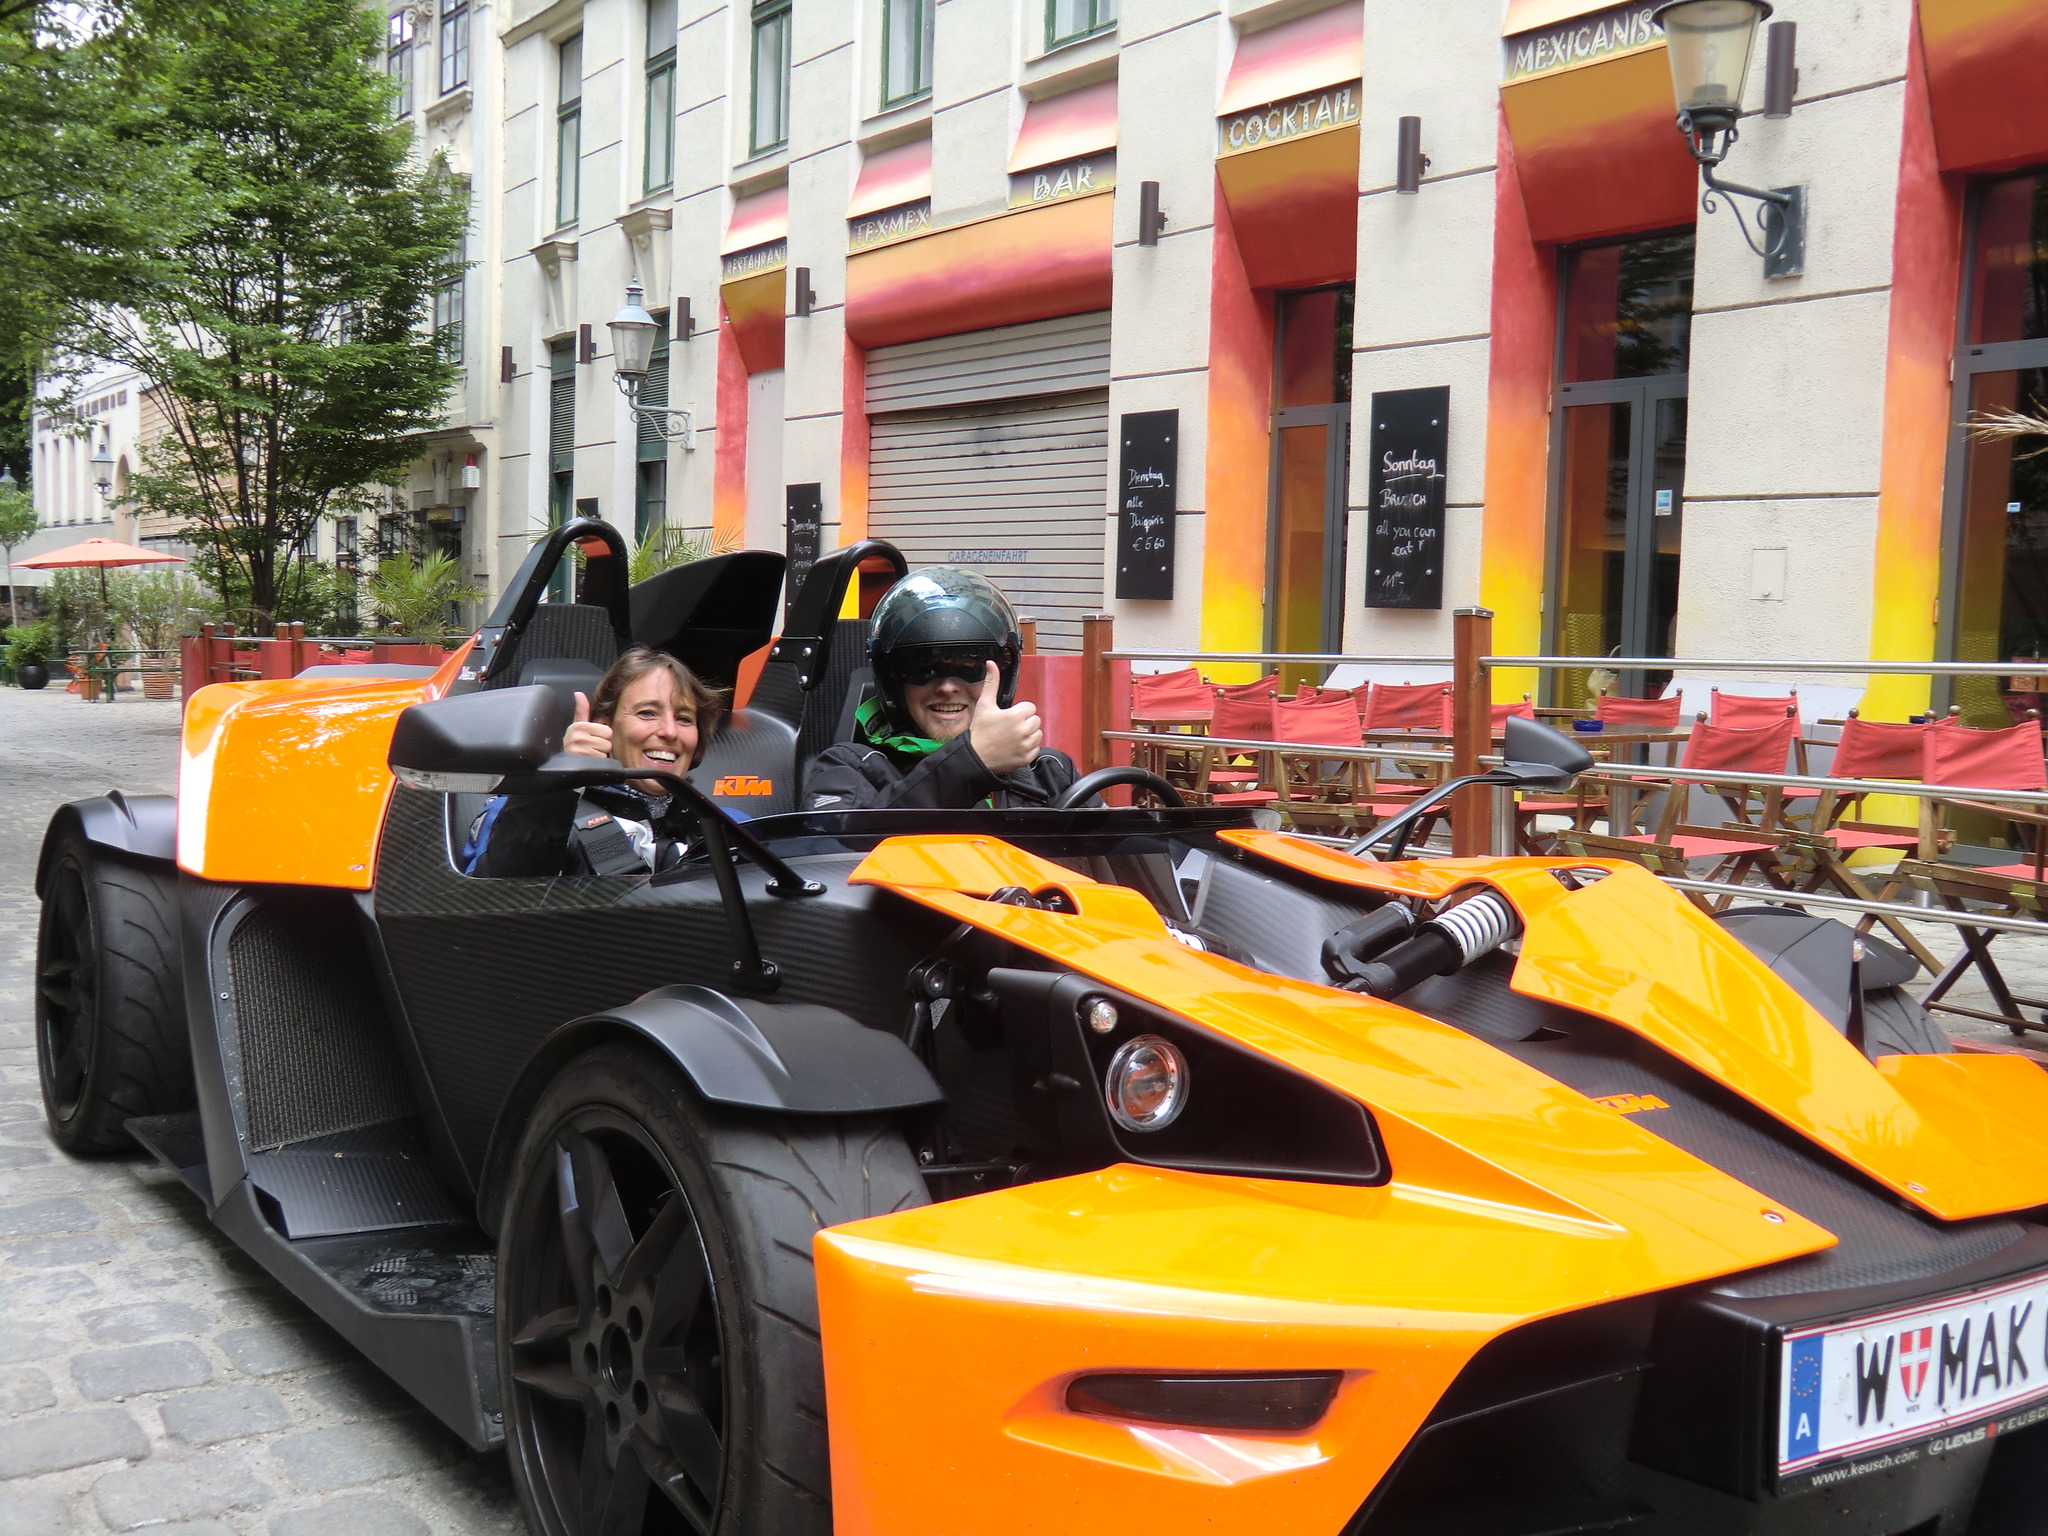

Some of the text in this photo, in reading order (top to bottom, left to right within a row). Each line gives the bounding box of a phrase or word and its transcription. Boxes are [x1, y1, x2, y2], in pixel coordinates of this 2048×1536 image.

[1511, 8, 1665, 77] MEXICANIS
[1229, 88, 1359, 149] COCKTAIL
[1033, 164, 1095, 201] BAR
[727, 245, 787, 277] RESTAURANT
[1127, 466, 1164, 488] Dienstag
[1382, 449, 1436, 479] Sonntag
[1126, 496, 1144, 508] alle
[1376, 519, 1436, 540] all you can
[947, 550, 1029, 562] GARAGENEINFAHRT
[1391, 540, 1413, 556] eat
[712, 775, 773, 796] KTM
[1856, 1334, 1894, 1427] W
[1937, 1300, 2033, 1406] MAK
[1795, 1412, 1812, 1440] A
[1811, 1448, 1919, 1487] www.keusch.com
[1945, 1426, 1986, 1450] LEXUS
